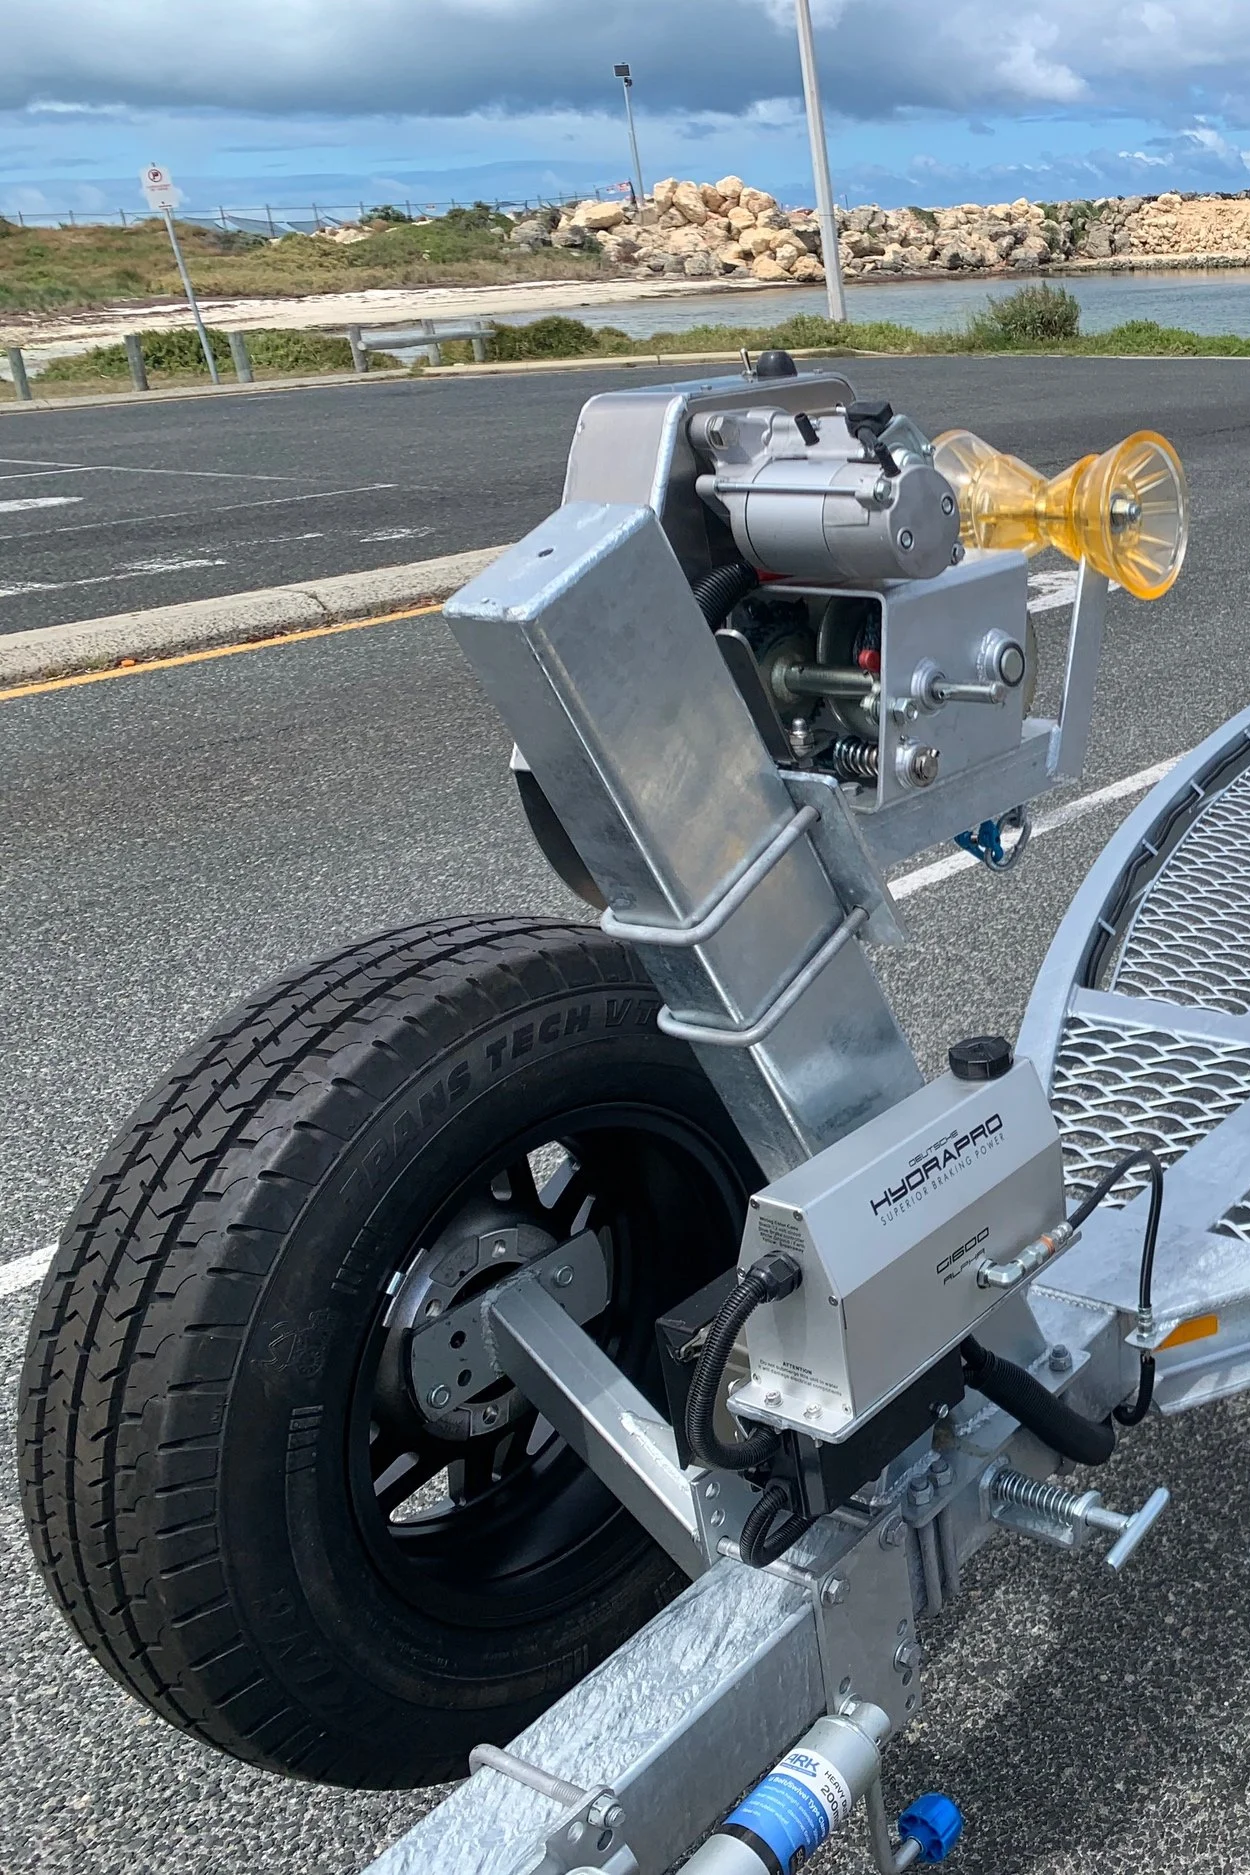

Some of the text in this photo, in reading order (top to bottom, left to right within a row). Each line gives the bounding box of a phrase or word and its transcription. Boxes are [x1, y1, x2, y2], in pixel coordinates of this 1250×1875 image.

[340, 1060, 472, 1204] TRANS
[484, 1004, 592, 1073] TECH
[870, 1113, 1003, 1216] HYDRAPRO
[908, 1129, 959, 1168] DEUTSCHE
[880, 1132, 1006, 1226] SUPERIOR BRAKING POWER
[943, 1247, 985, 1286] ALPHA
[782, 1360, 813, 1376] ATTENTION
[784, 1753, 820, 1772] ARK
[824, 1770, 845, 1799] HEAVY
[808, 1798, 820, 1817] Type
[820, 1784, 840, 1827] 200m
